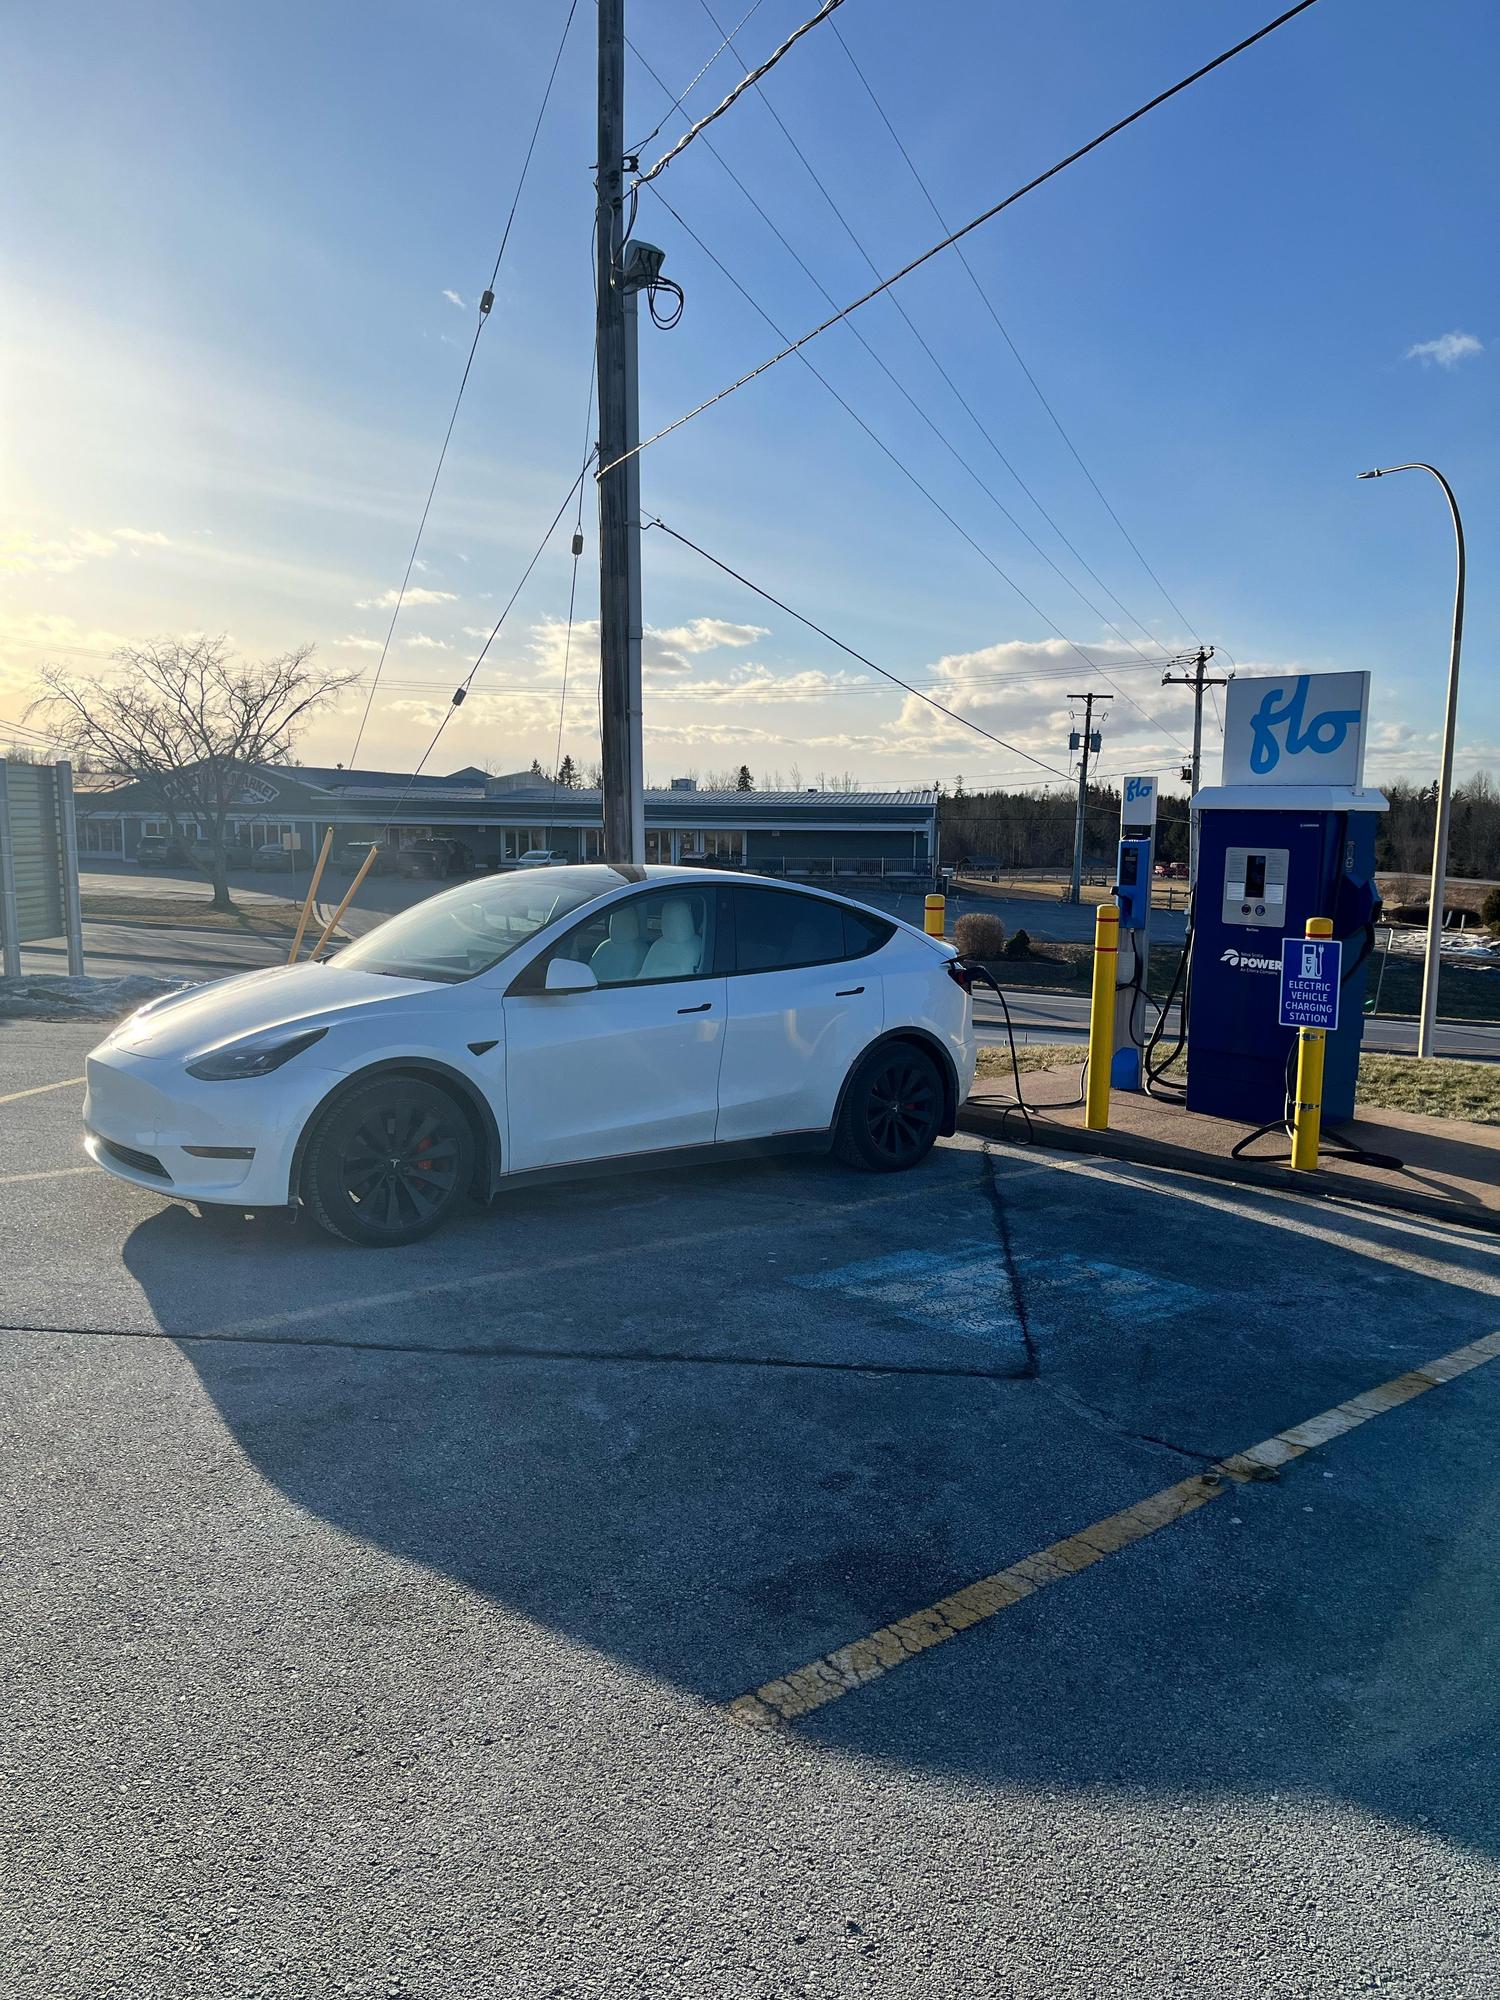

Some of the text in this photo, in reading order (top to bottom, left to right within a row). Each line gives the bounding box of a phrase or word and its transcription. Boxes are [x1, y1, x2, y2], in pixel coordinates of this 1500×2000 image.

[1249, 675, 1360, 774] flo
[1127, 777, 1152, 801] flo
[1240, 957, 1282, 970] POWER
[1289, 980, 1331, 991] ELECTRIC
[1291, 991, 1328, 1002] VEHICLE
[1285, 1001, 1333, 1013] CHARGING
[1289, 1012, 1328, 1023] STATION
